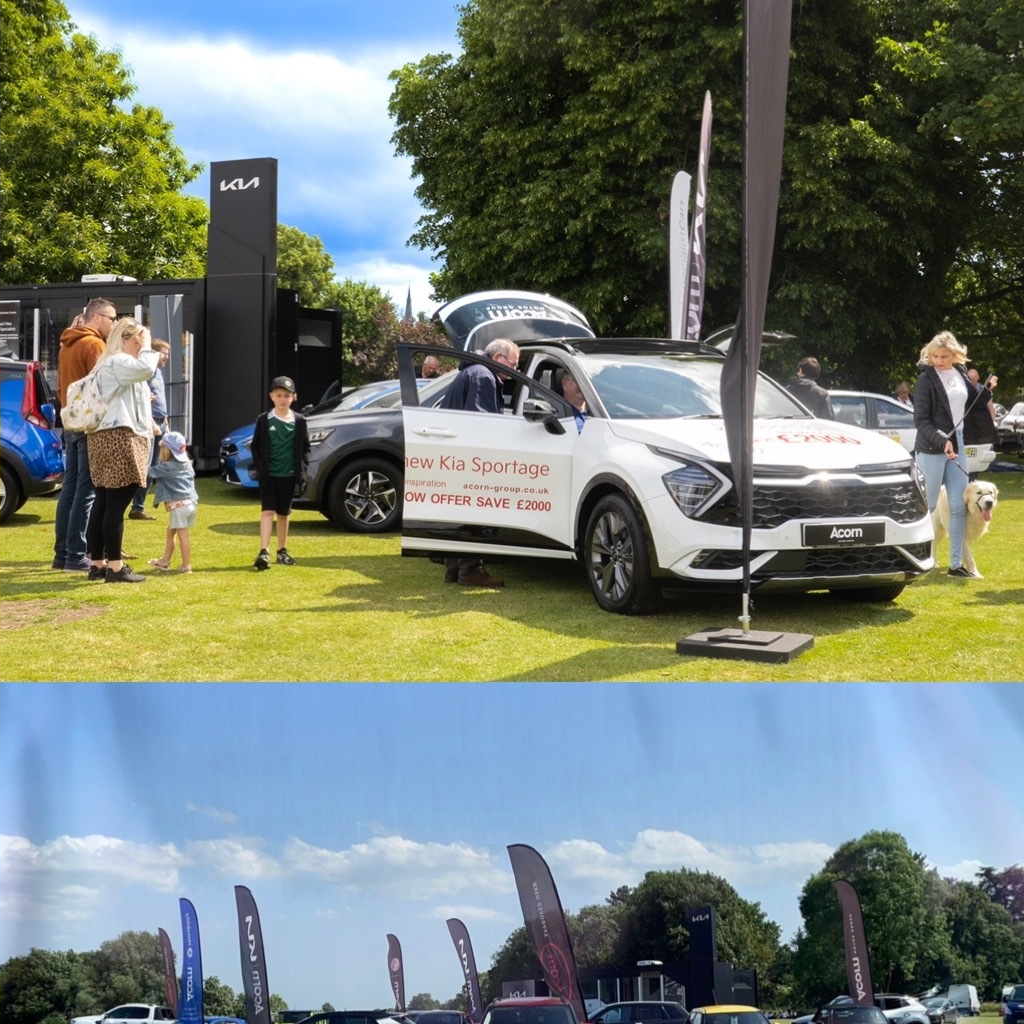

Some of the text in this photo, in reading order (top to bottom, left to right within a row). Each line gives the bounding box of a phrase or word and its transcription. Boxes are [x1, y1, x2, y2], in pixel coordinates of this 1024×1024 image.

[220, 176, 260, 193] KIA
[488, 308, 547, 320] Acorn
[440, 455, 466, 471] Kia
[471, 457, 550, 479] Sportage
[463, 483, 549, 494] acorn-group.co.uk
[405, 492, 552, 512] OW OFFER SAVE £2000
[830, 526, 863, 539] Acorn
[692, 914, 710, 922] KIA
